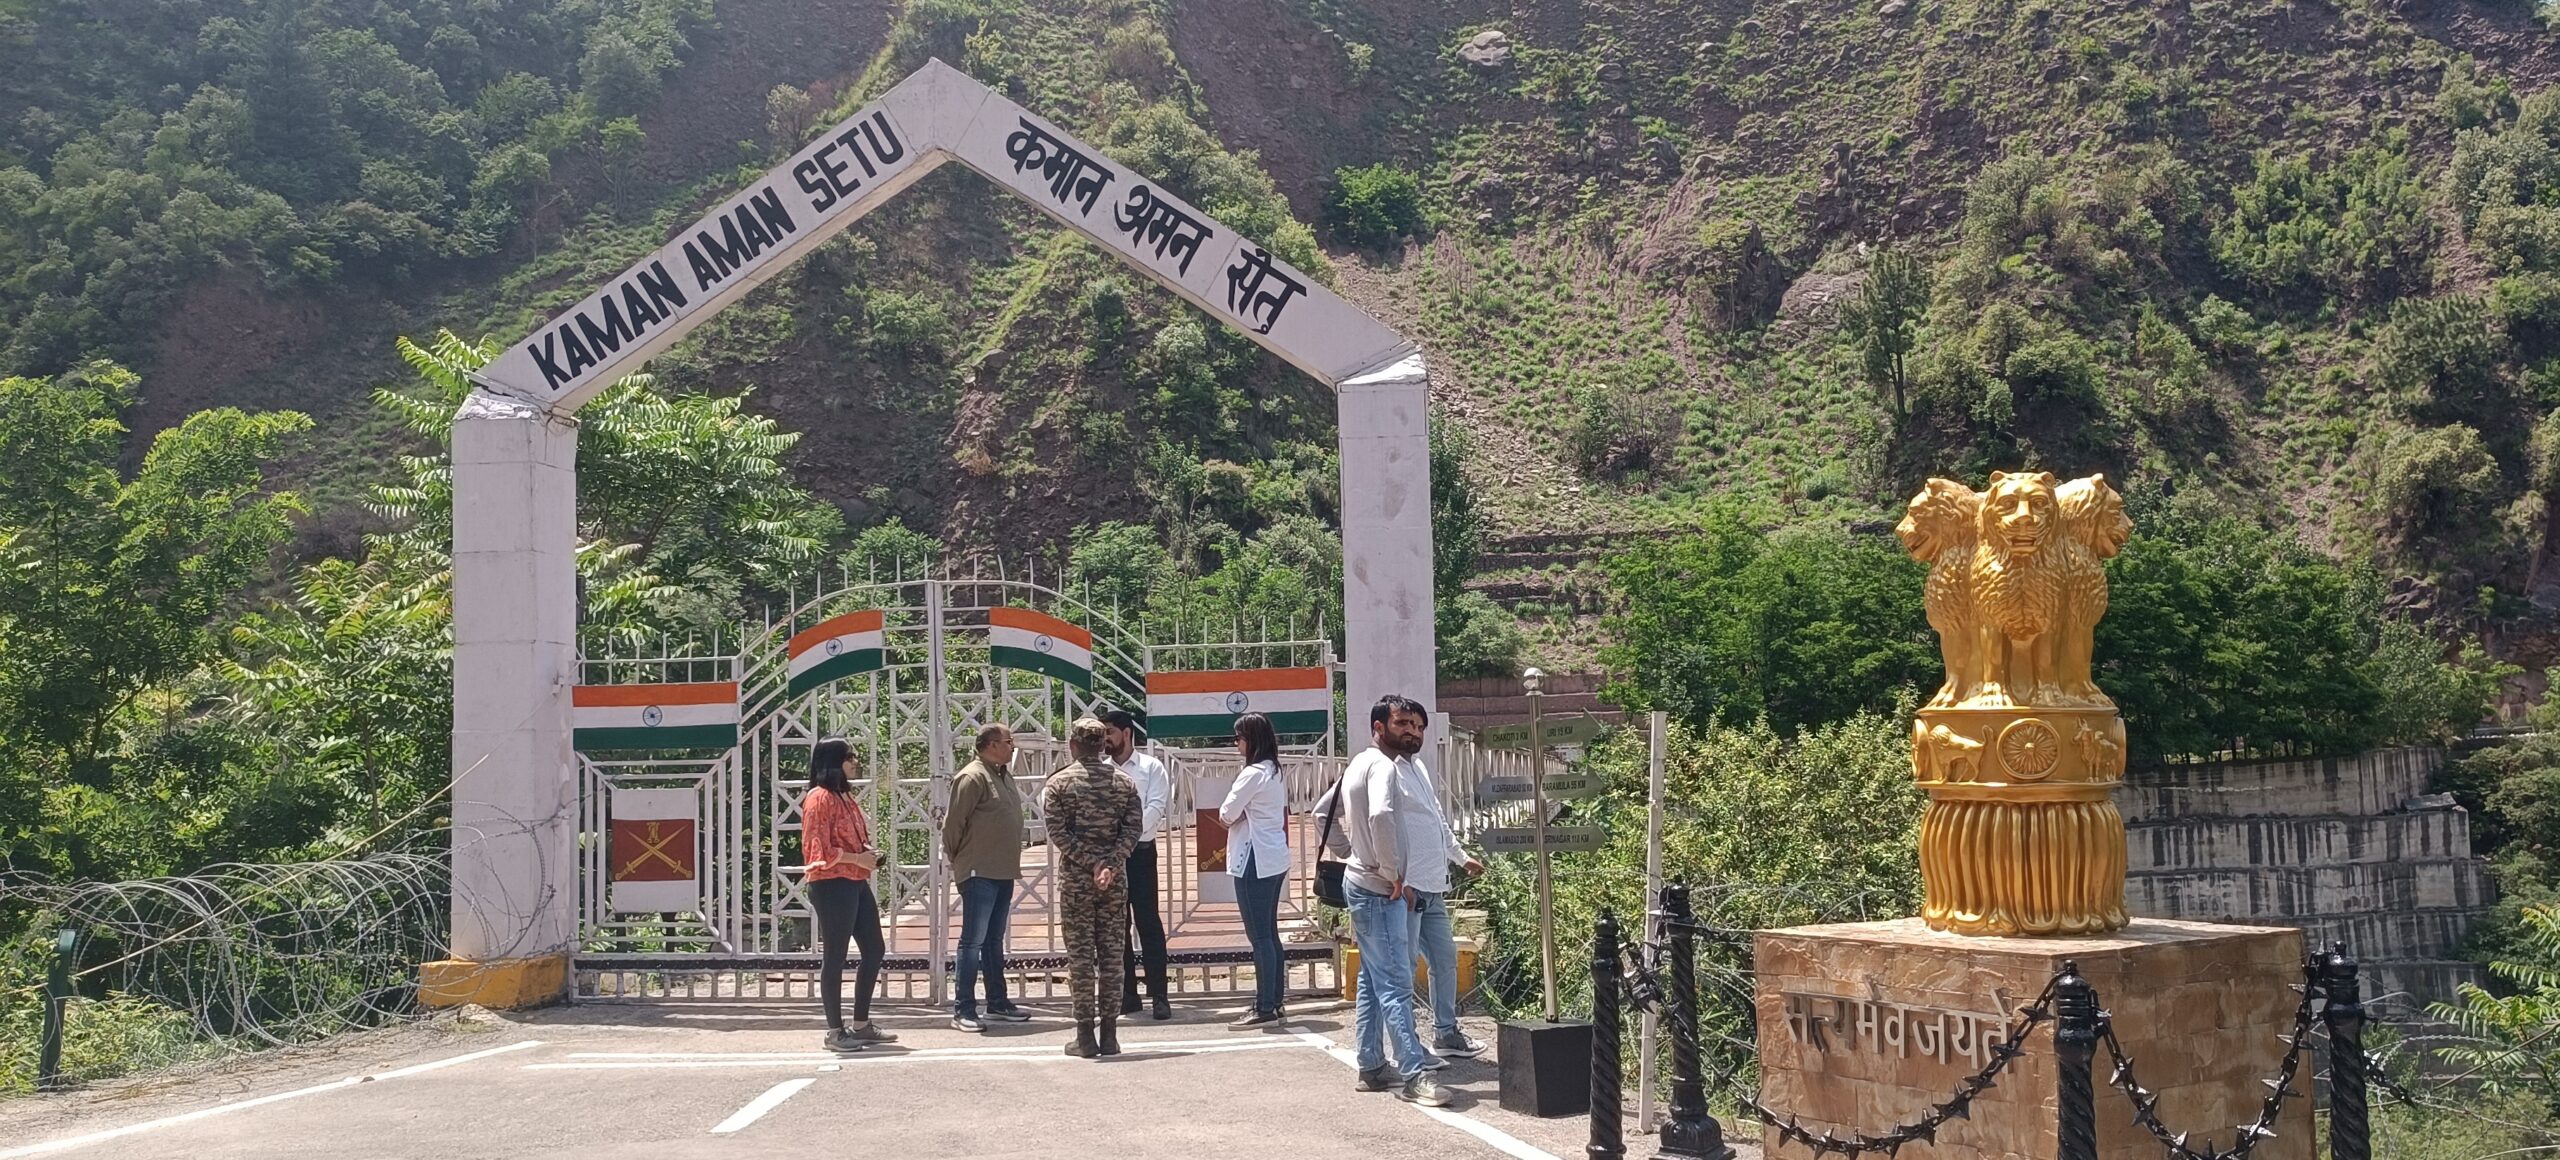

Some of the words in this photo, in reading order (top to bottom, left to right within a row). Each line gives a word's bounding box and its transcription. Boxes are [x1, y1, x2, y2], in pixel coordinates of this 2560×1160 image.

[1005, 116, 1115, 217] कमान
[1114, 185, 1213, 278] अमन
[1226, 247, 1307, 335] सेतु
[528, 260, 688, 391] KAMAN
[682, 186, 797, 292] AMAN
[792, 111, 903, 213] SETU
[1520, 731, 1529, 741] KM
[1547, 728, 1557, 738] URI
[1564, 725, 1574, 735] KM
[1577, 779, 1586, 789] KM
[1527, 835, 1535, 844] KM
[1580, 833, 1590, 843] KM
